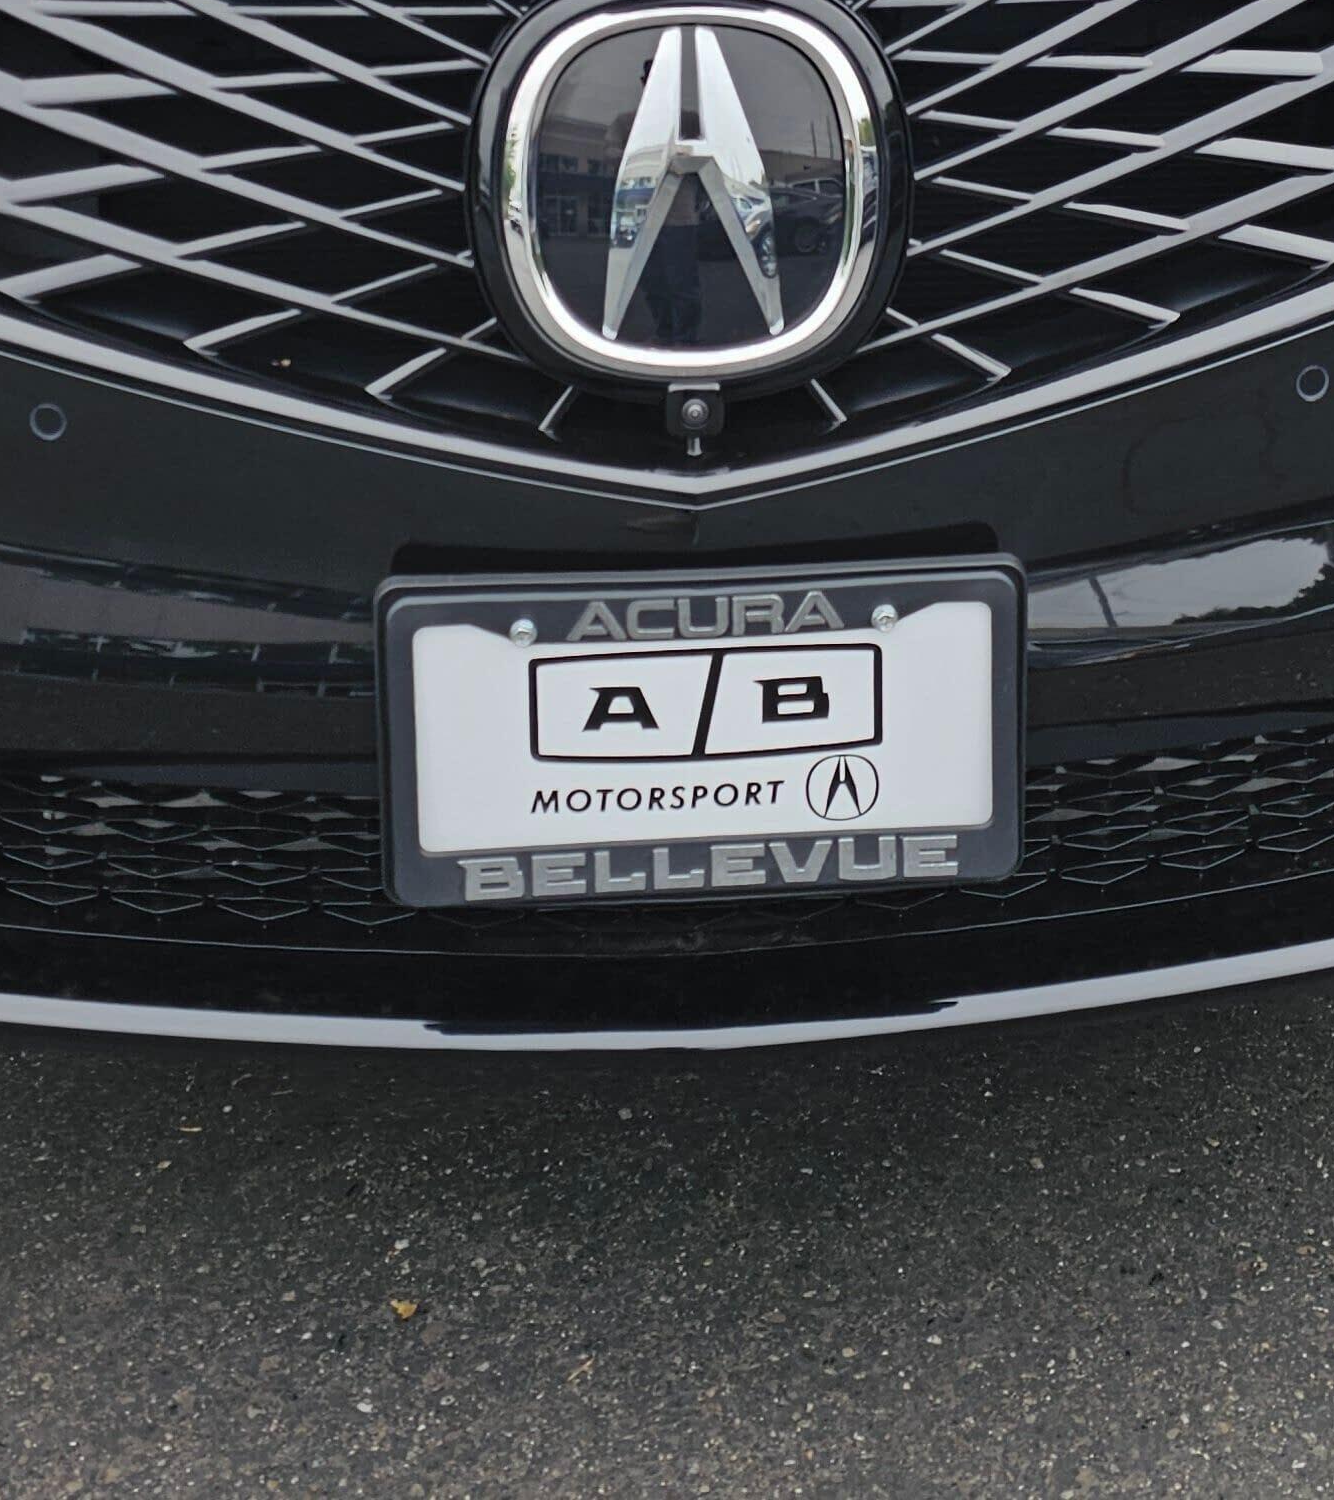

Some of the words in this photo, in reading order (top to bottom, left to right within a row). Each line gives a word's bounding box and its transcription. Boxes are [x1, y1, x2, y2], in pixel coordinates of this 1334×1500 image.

[567, 589, 846, 642] ACURA
[530, 779, 786, 814] MOTORSPORT
[456, 833, 959, 901] BELLEVUE
